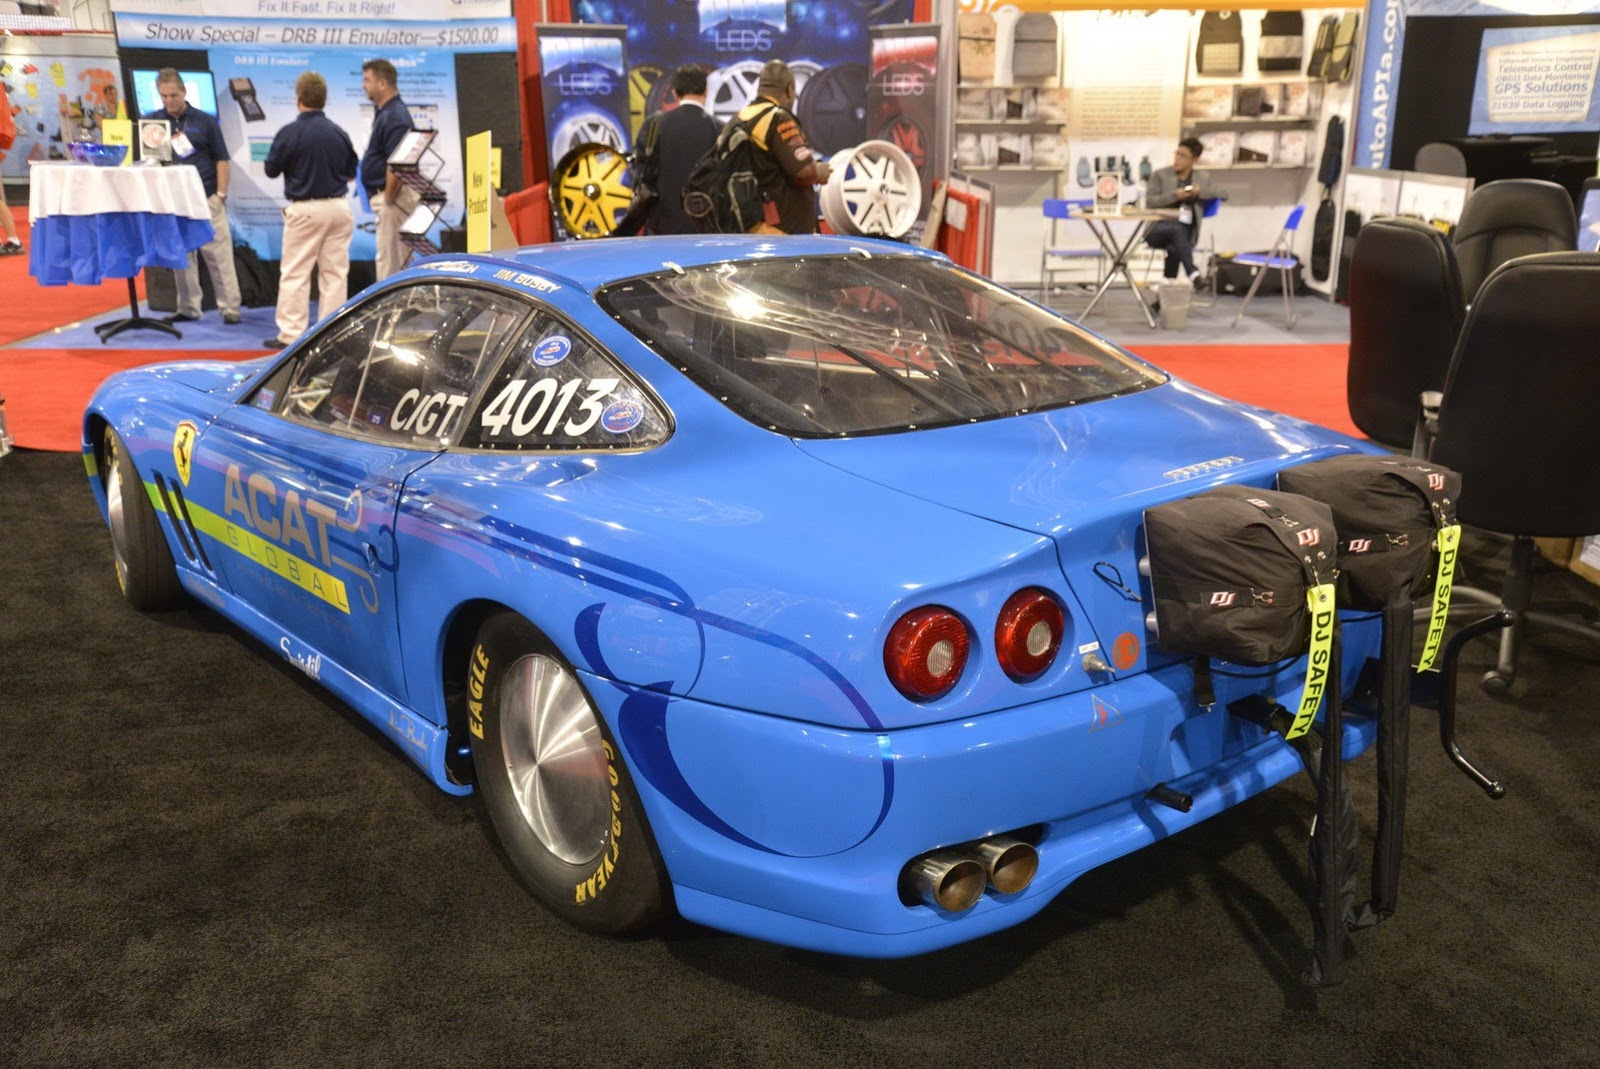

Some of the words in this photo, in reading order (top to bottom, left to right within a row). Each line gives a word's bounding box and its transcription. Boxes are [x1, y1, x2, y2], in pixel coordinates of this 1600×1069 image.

[258, 0, 277, 12] Fix
[281, 1, 288, 12] It
[292, 1, 321, 14] Fast,
[327, 2, 344, 13] Fix
[349, 2, 356, 13] It
[360, 2, 396, 16] Right!
[145, 23, 195, 40] Show
[200, 26, 260, 45] Special
[281, 27, 317, 44] DRB
[322, 28, 343, 44] III
[715, 29, 772, 52] LEDS
[1499, 64, 1551, 73] Telematics
[1554, 63, 1593, 72] Control
[1545, 72, 1591, 81] Monitoring
[558, 73, 612, 96] LEDS
[882, 73, 925, 97] LEDS
[1494, 82, 1522, 94] GPS
[1525, 81, 1589, 94] Solutions
[1523, 101, 1545, 109] Data
[1547, 99, 1585, 109] Logging
[472, 171, 483, 188] New
[468, 196, 488, 215] Product
[481, 377, 620, 437] 4013
[1426, 473, 1446, 491] DJ
[224, 463, 338, 568] ACAT
[1296, 528, 1321, 547] DJ
[1348, 539, 1373, 553] DJ
[227, 525, 348, 608] GLOBAL
[1441, 548, 1456, 578] DJ
[1210, 591, 1236, 607] DJ
[1314, 611, 1332, 643] DJ
[1423, 584, 1450, 666] SAFETY
[469, 643, 491, 740] EAGLE
[1294, 649, 1329, 734] SAFETY
